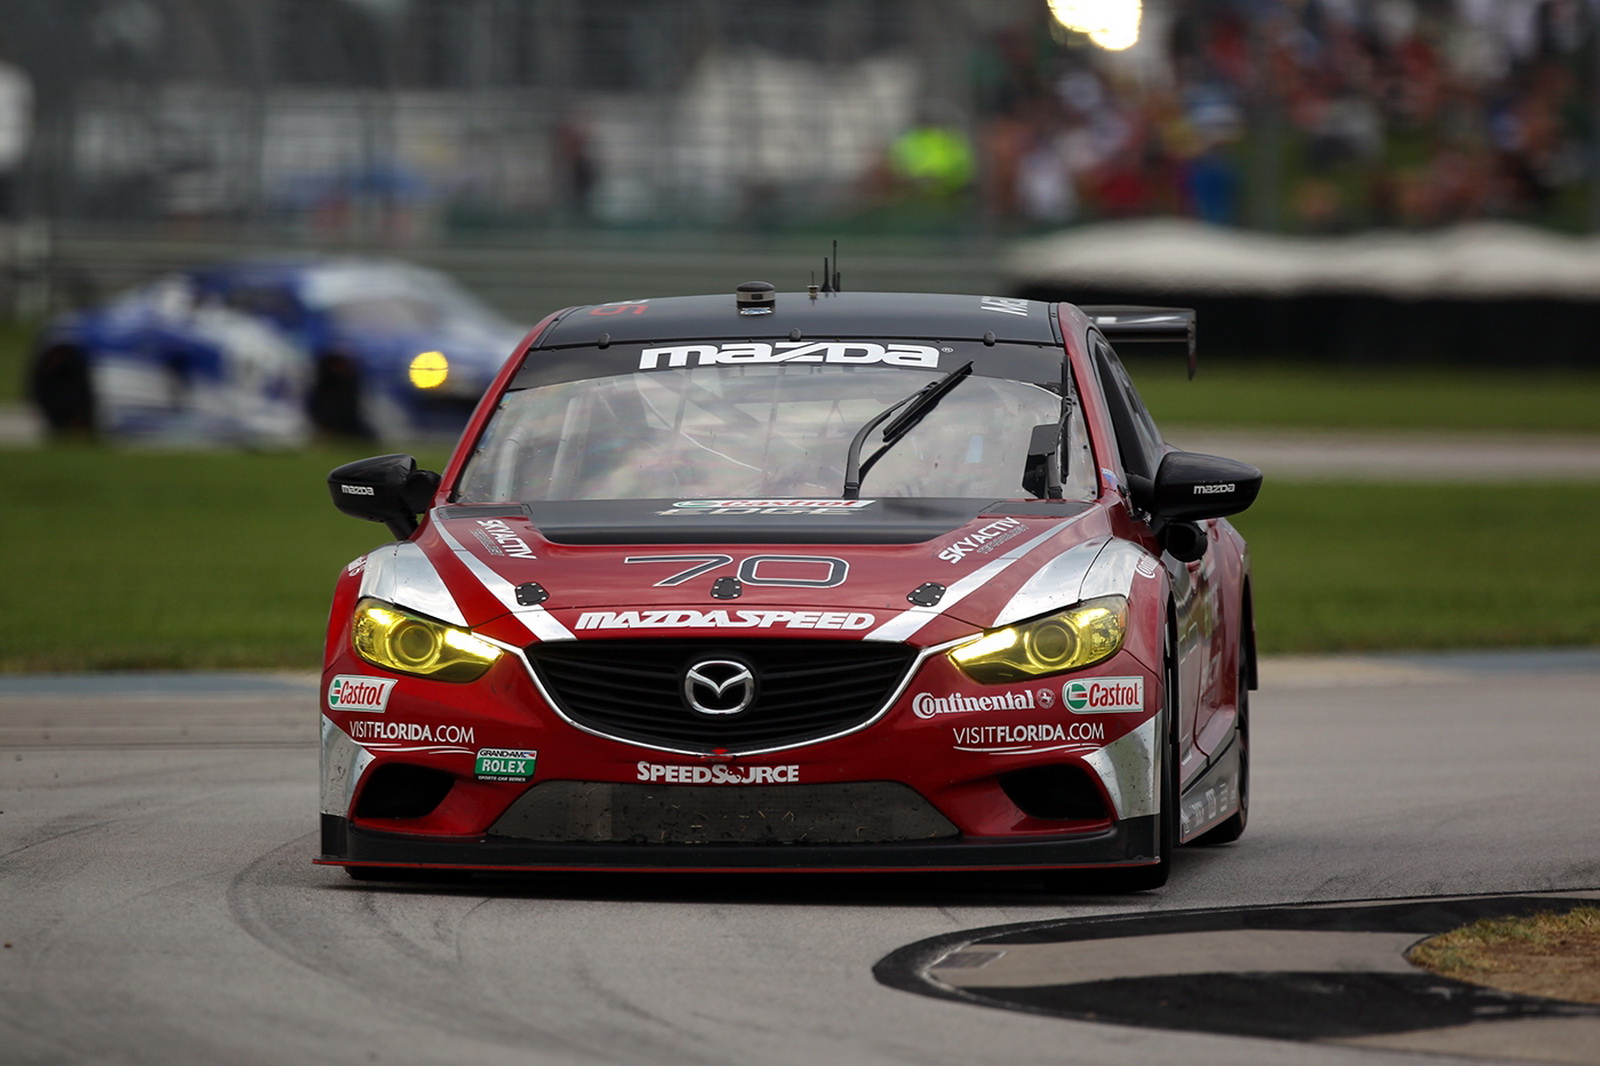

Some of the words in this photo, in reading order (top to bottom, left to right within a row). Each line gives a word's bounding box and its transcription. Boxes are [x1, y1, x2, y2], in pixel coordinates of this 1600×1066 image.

[639, 341, 940, 370] mazda
[341, 484, 375, 496] mazda
[1193, 483, 1236, 495] mazda
[476, 519, 538, 560] SKYACTIV
[938, 516, 1021, 565] SKYACTIV
[623, 554, 850, 589] 70
[574, 609, 876, 631] MAZDASPEED
[339, 680, 385, 706] Castrol
[912, 689, 1037, 720] Continental
[1088, 682, 1141, 708] Castrol
[349, 720, 476, 744] VISITFLORIDA.COM
[952, 722, 1106, 745] VISITFLORIDA.COM
[481, 759, 527, 774] ROLEX
